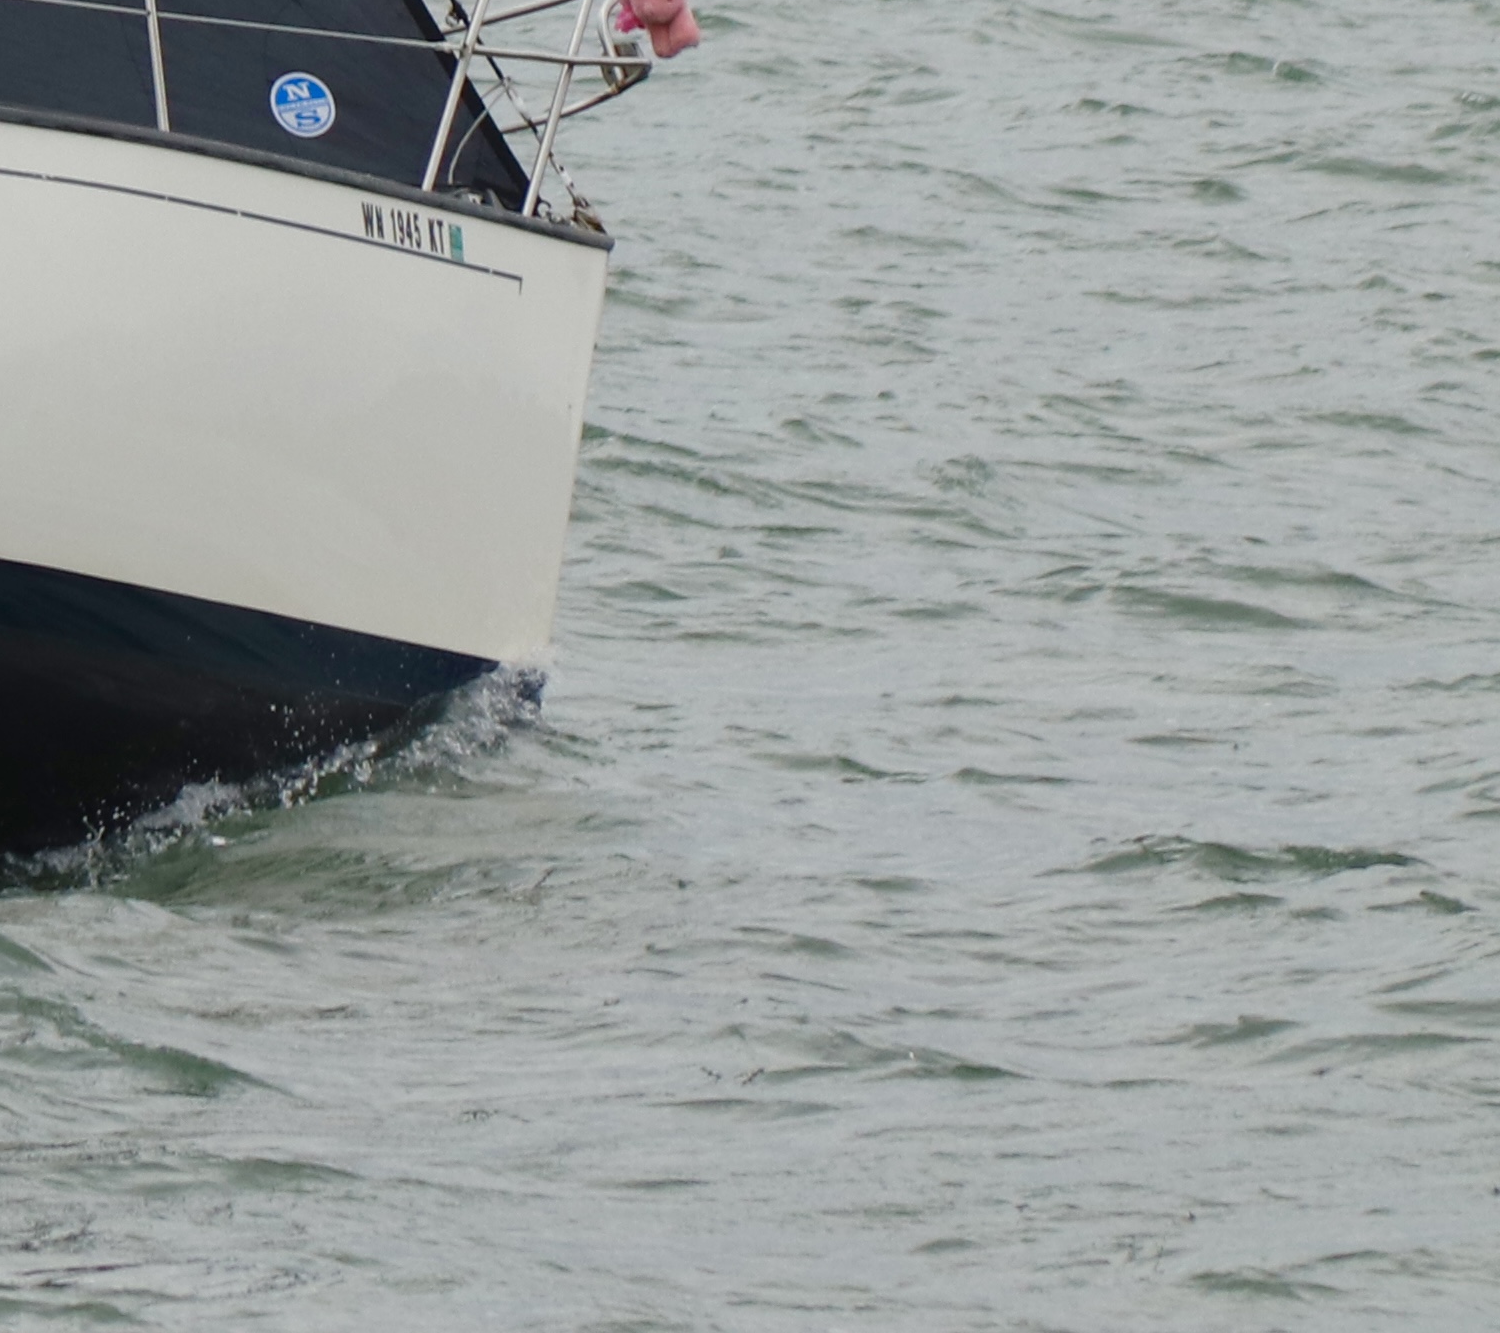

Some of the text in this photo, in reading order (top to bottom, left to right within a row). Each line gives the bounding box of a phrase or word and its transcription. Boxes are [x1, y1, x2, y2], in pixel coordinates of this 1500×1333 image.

[361, 200, 445, 255] WN 1945 KT
